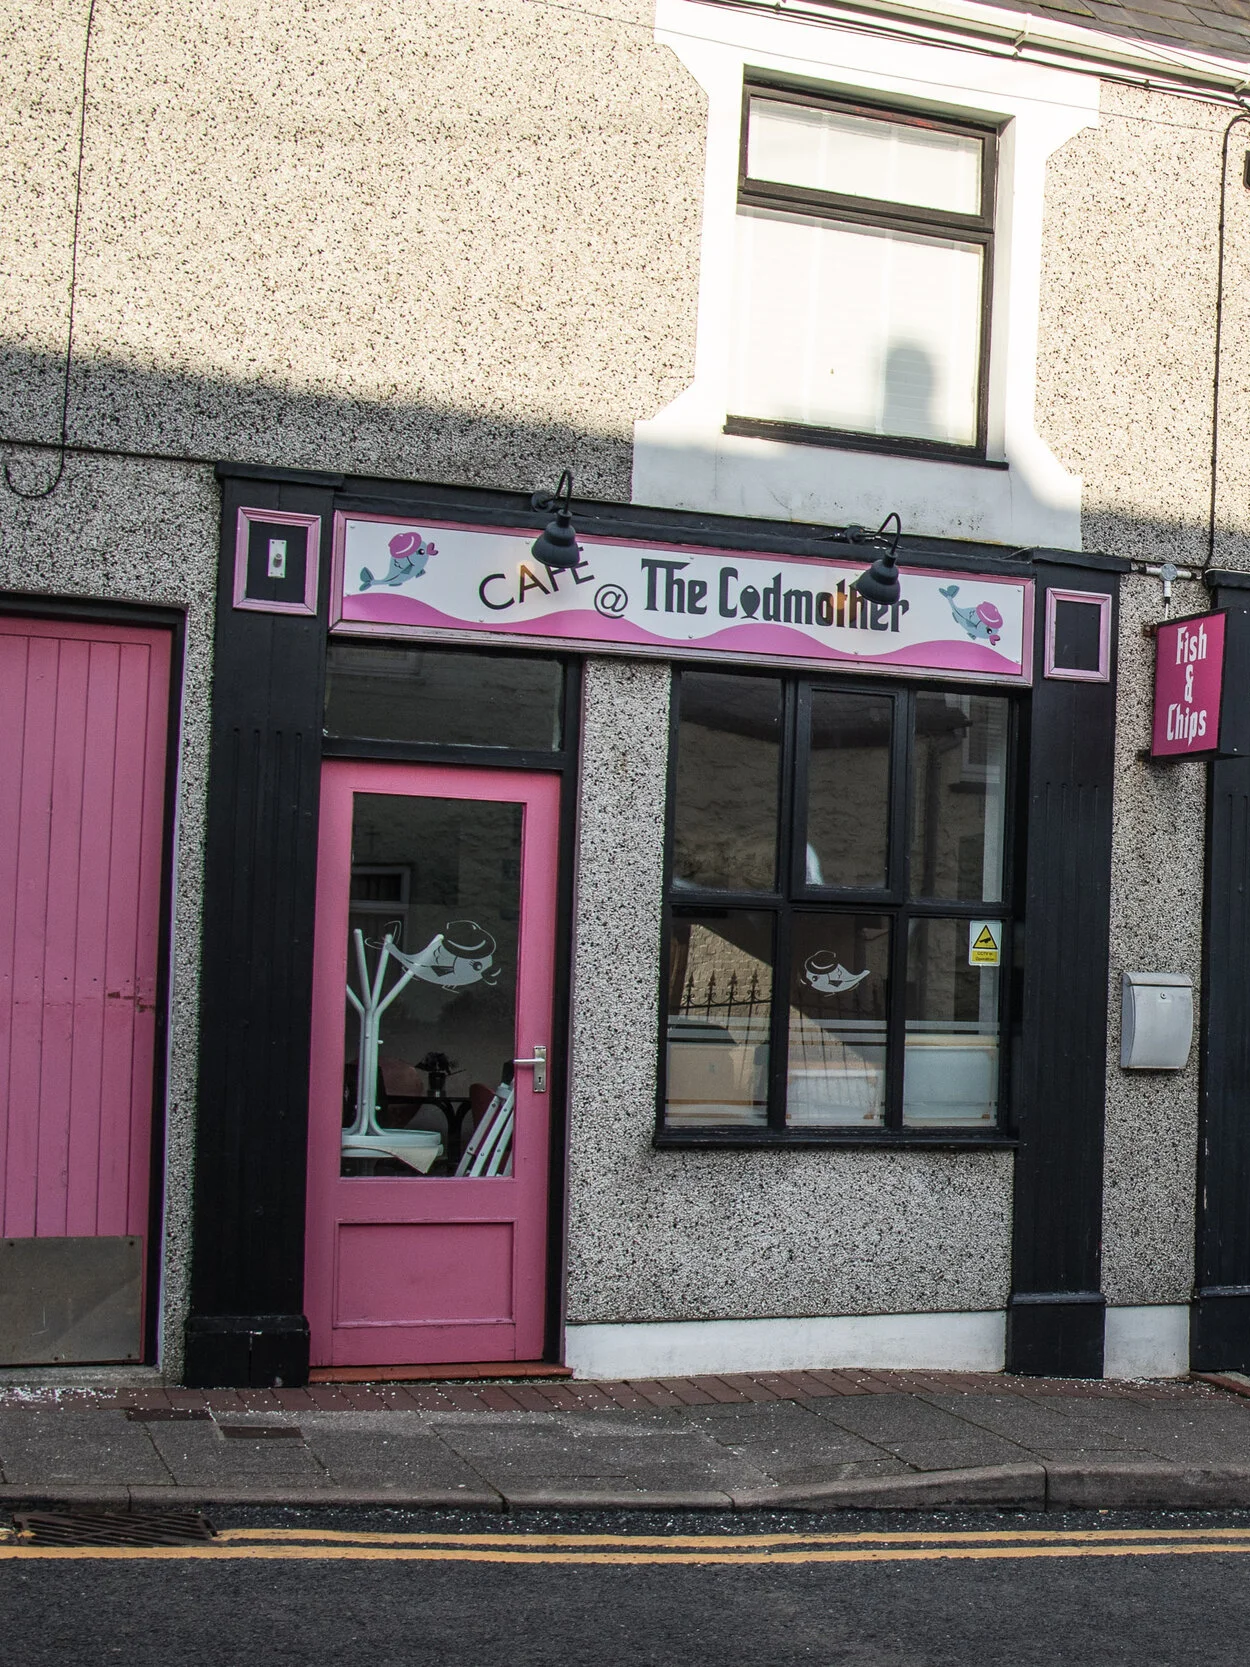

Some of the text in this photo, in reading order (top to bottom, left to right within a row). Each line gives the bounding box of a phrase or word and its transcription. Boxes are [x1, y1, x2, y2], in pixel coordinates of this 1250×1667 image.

[594, 583, 629, 619] @
[641, 558, 707, 616] The
[718, 566, 910, 633] Codmother
[1175, 622, 1208, 665] Fish
[1184, 664, 1194, 703] &
[1166, 703, 1207, 746] Chips
